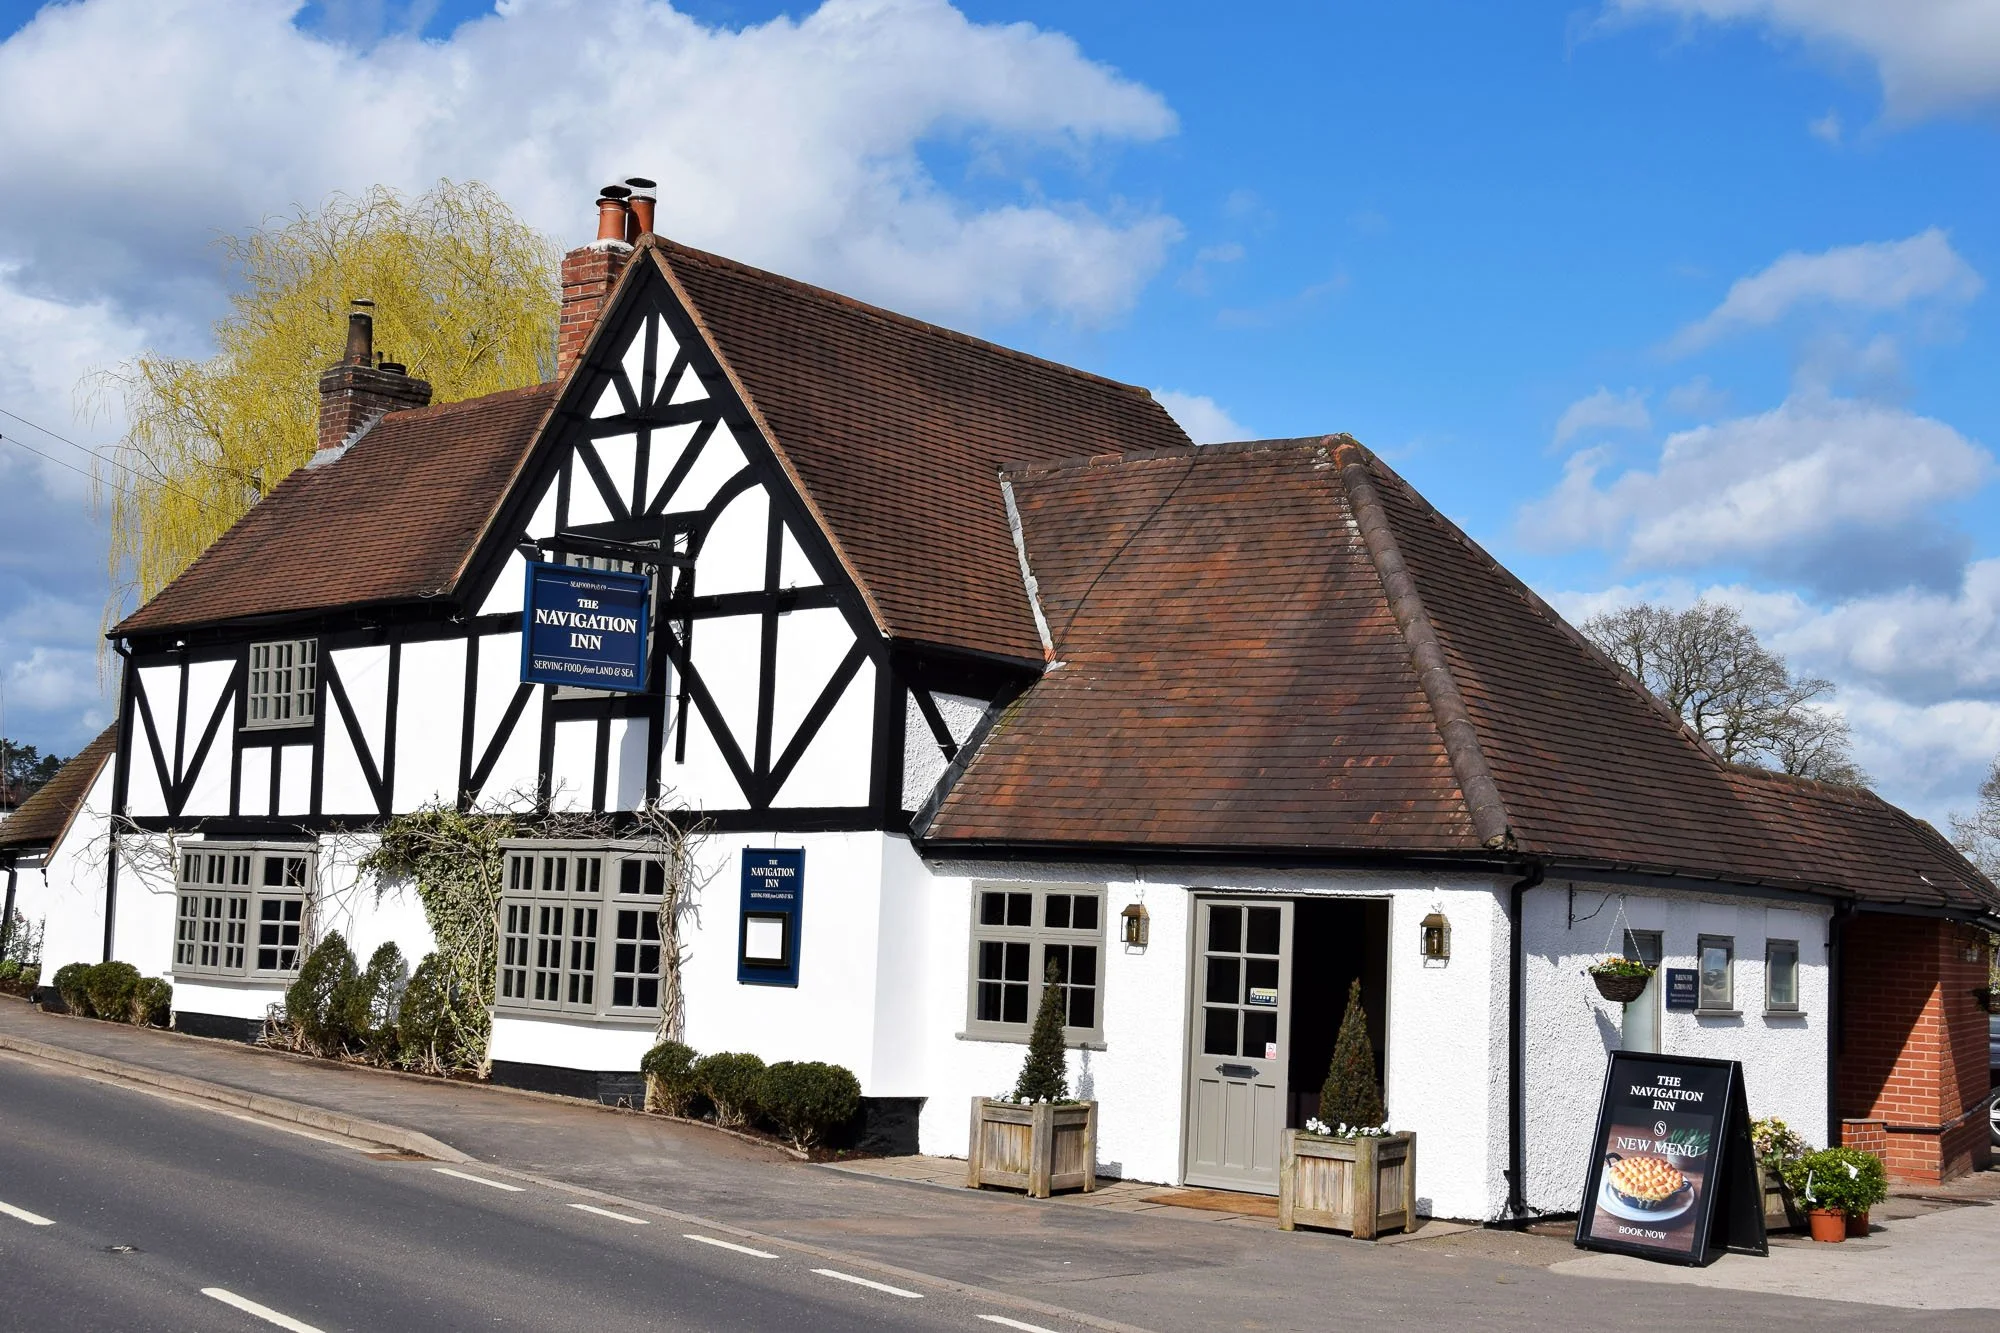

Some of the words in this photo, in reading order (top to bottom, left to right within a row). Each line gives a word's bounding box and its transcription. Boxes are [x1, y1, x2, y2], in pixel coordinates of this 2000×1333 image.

[577, 598, 599, 610] THE
[535, 608, 638, 634] NAVIGATION
[570, 632, 602, 650] INN
[533, 660, 563, 671] SERVING
[563, 663, 581, 673] FOOD
[580, 665, 595, 675] from
[595, 666, 614, 676] LAND
[613, 667, 620, 676] &
[620, 668, 634, 678] SEA
[751, 867, 795, 877] NAVIGATION
[765, 878, 779, 888] INN
[1657, 1075, 1681, 1087] THE
[1630, 1085, 1704, 1102] NAVIGATION
[1652, 1100, 1676, 1111] INN
[1616, 1137, 1651, 1152] NEW
[1653, 1141, 1699, 1158] MENU
[1618, 1226, 1643, 1237] BOOK
[1644, 1229, 1667, 1240] NOW
